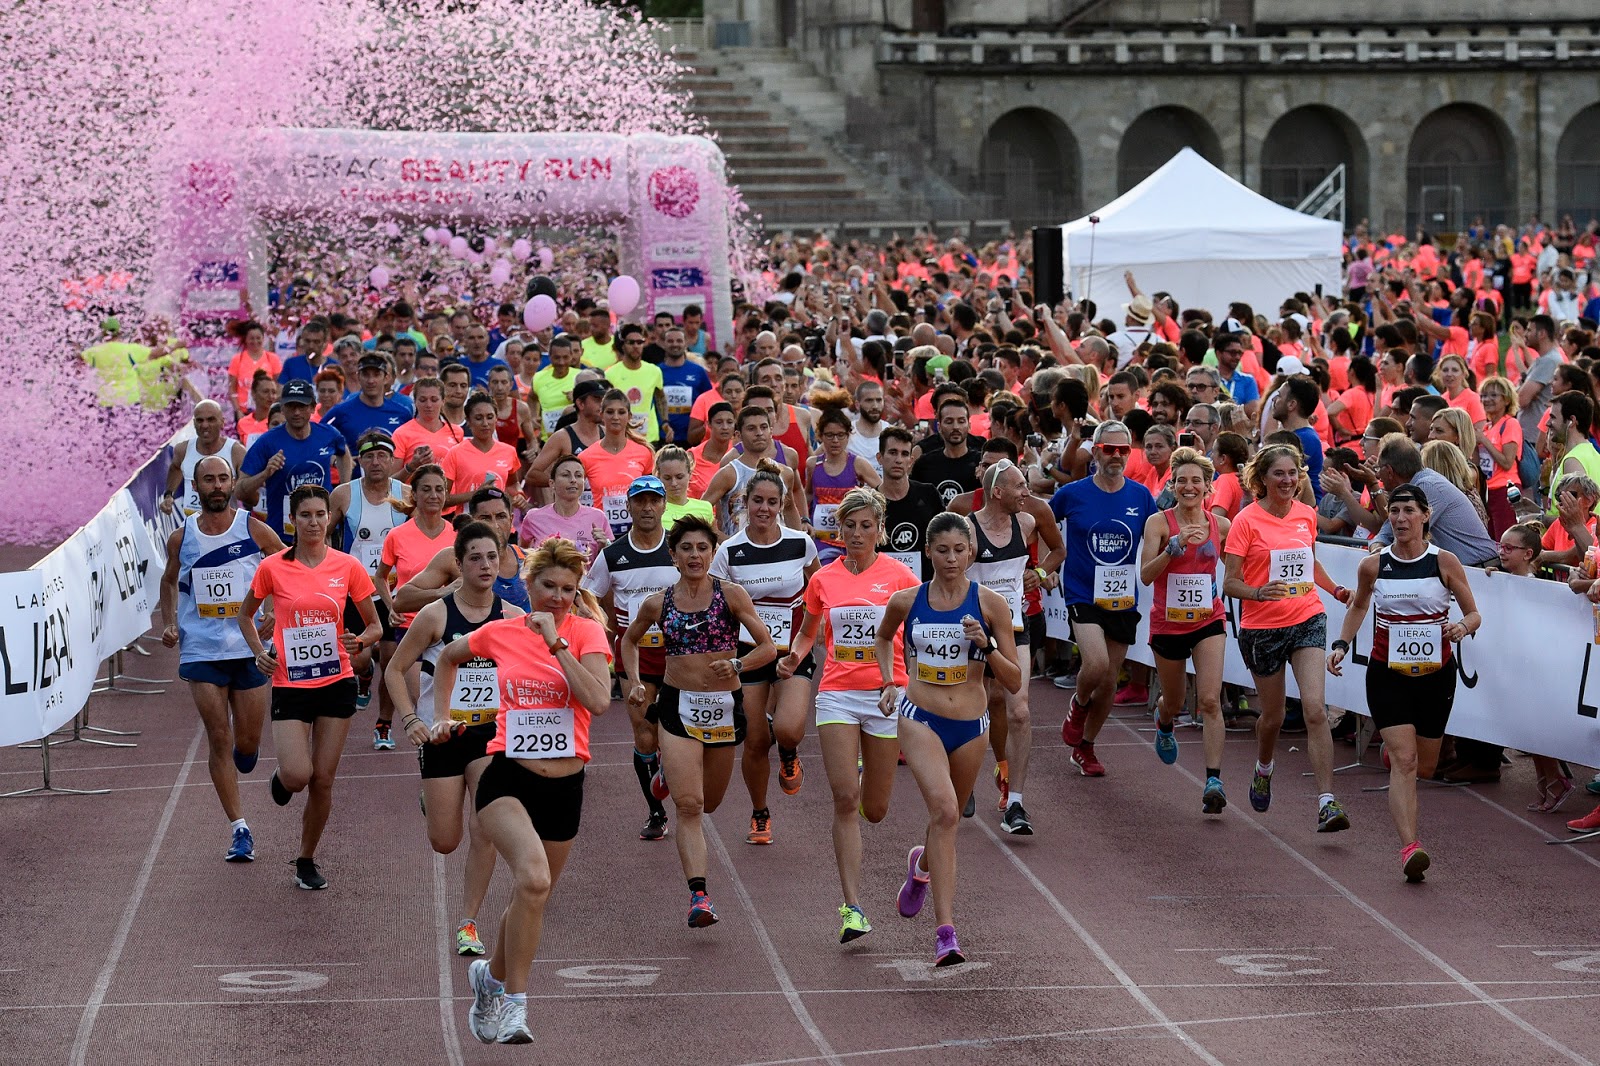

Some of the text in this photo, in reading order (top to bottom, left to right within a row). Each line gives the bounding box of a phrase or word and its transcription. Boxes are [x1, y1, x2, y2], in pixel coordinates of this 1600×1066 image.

[289, 154, 612, 183] IERAC BEAUTY RUN
[668, 394, 687, 404] 256
[606, 509, 629, 520] 150
[820, 516, 836, 526] 39
[1099, 539, 1129, 547] BEAUTY
[1279, 552, 1307, 562] LIERAC
[201, 571, 234, 581] LIERAC
[1103, 569, 1128, 578] LIERAC
[1280, 564, 1304, 578] 313
[1103, 579, 1128, 593] 324
[1175, 578, 1205, 587] LIERAC
[206, 583, 231, 597] 101
[1178, 590, 1203, 603] 315
[301, 609, 331, 617] LIERAC
[840, 611, 876, 620] LIERAC
[292, 629, 327, 641] LIERAC
[842, 624, 876, 640] 234
[922, 630, 961, 640] LIERAC
[1398, 630, 1432, 638] LIERAC
[290, 643, 333, 661] 1505
[925, 644, 961, 660] 449
[1397, 642, 1434, 656] 400
[459, 674, 495, 682] LIERAC
[951, 671, 967, 679] 10K
[515, 679, 555, 690] LIERAC
[459, 687, 493, 703] 272
[517, 687, 564, 700] BEAUTY
[518, 696, 543, 706] RUN
[689, 697, 725, 706] LIERAC
[518, 715, 562, 726] LIERAC
[689, 708, 724, 724] 398
[513, 733, 568, 752] 2298
